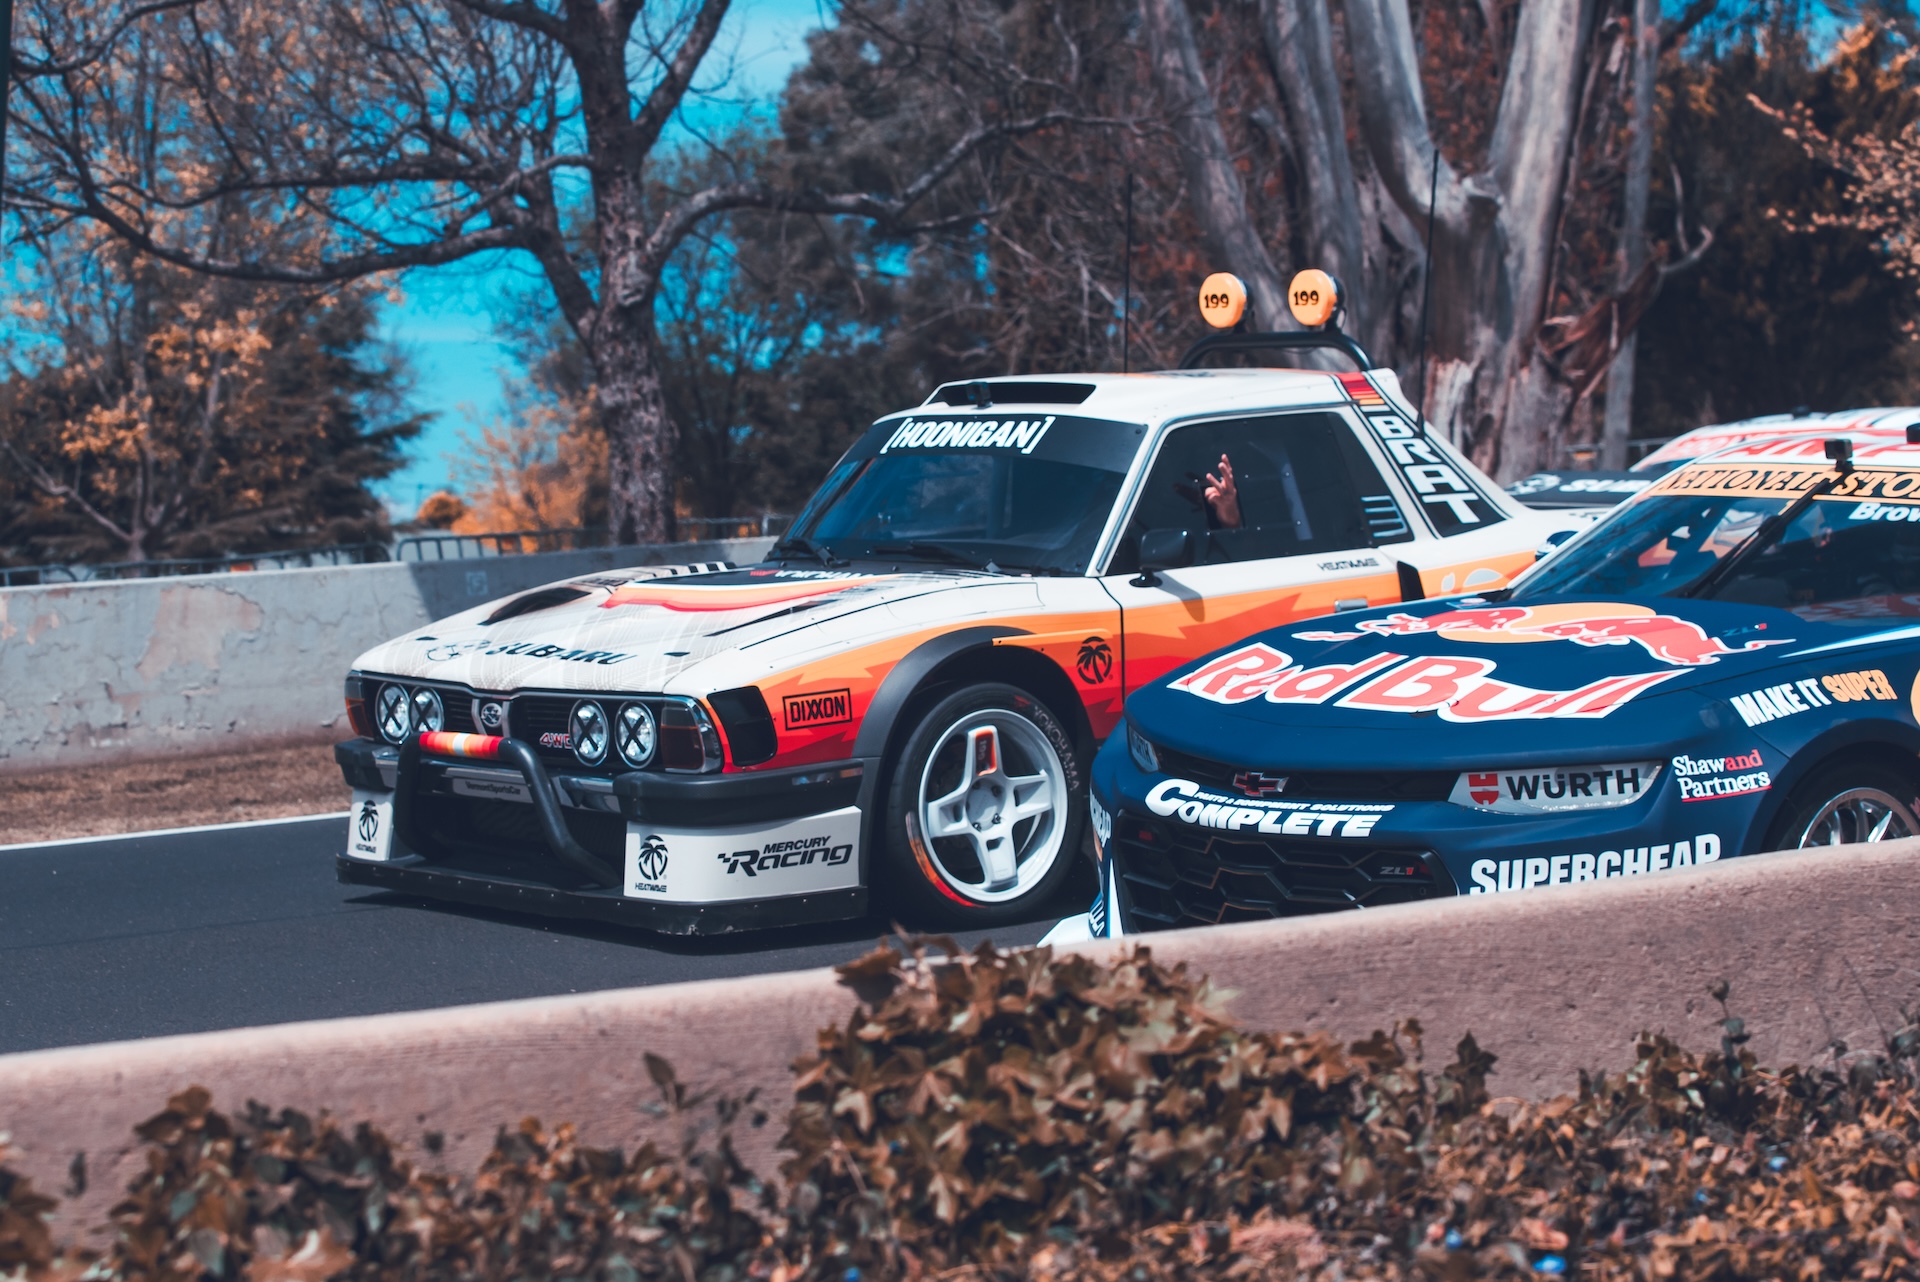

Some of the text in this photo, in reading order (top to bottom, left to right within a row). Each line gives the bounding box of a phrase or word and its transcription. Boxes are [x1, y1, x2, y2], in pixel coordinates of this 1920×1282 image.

[1204, 293, 1229, 309] 199
[1293, 290, 1319, 306] 199
[1368, 414, 1480, 524] BRAT
[485, 642, 638, 665] SUBARU
[789, 695, 846, 723] DIXXON
[1729, 669, 1898, 728] MAKE IT SUPER
[1677, 771, 1771, 799] Partners
[1309, 804, 1396, 812] SOLUTIONS
[763, 835, 832, 856] MERCURY
[726, 844, 853, 877] Racing
